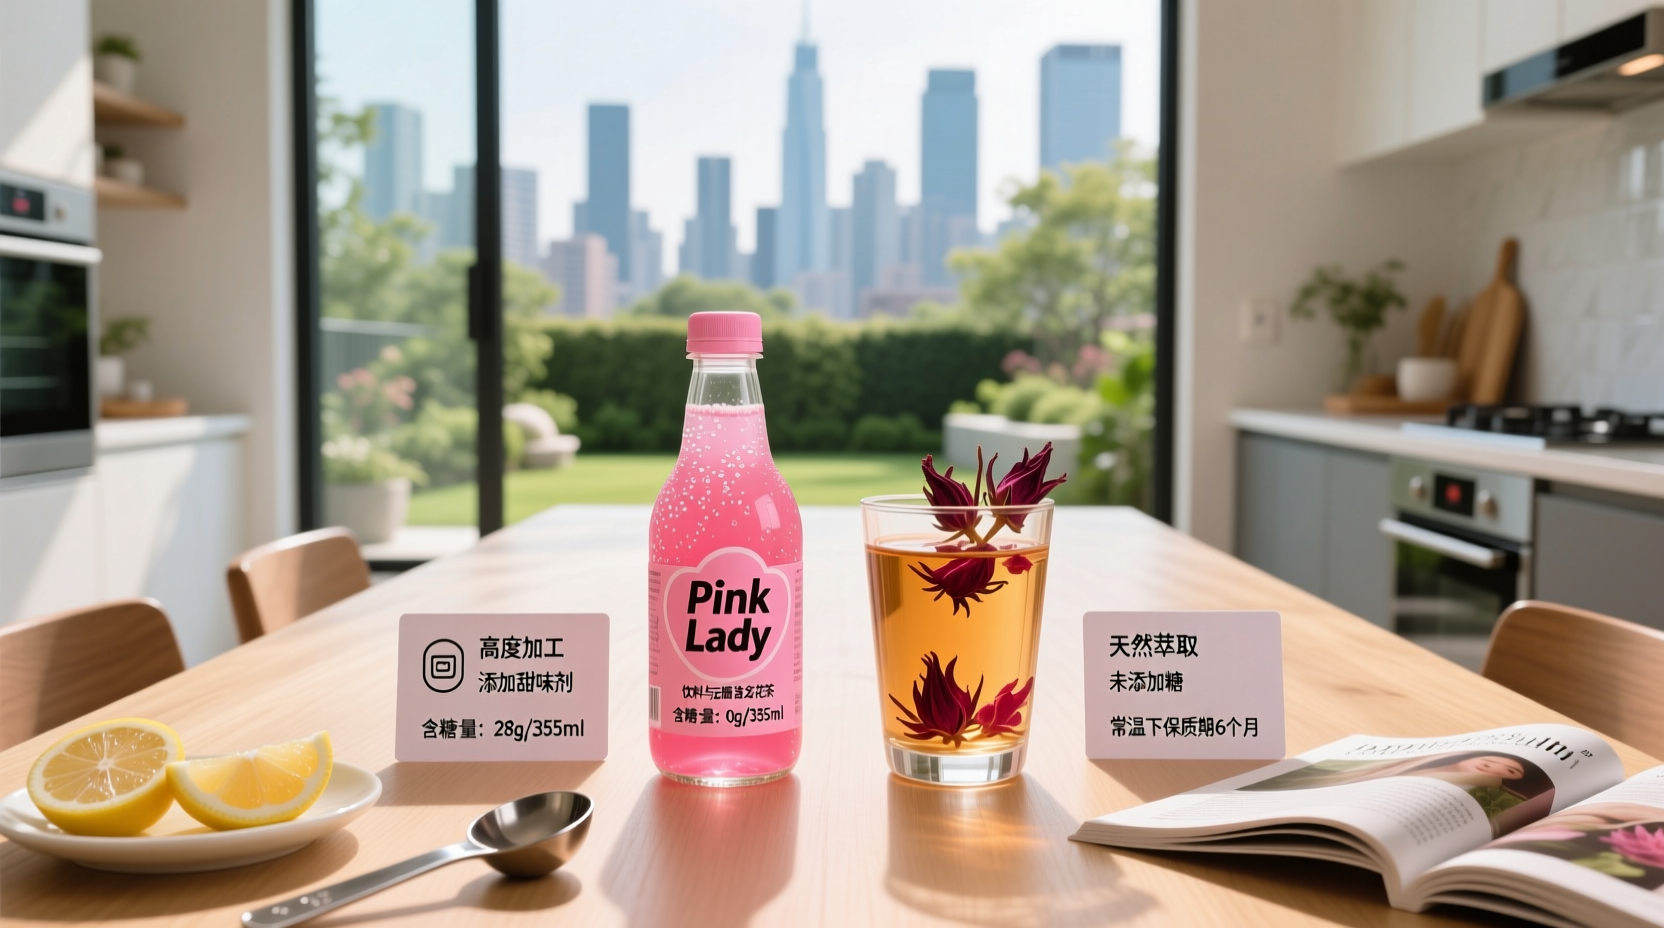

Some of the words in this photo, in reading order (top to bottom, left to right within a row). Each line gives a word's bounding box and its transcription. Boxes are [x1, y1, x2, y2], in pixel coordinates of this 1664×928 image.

[686, 577, 771, 615] Pink
[479, 635, 565, 660] 高度加工
[685, 617, 772, 662] Lady
[1109, 632, 1199, 658] 天然萃取
[477, 671, 573, 694] 添加甜味剂
[1109, 670, 1184, 693] 未添加糖
[1110, 715, 1259, 738] 常温下保质期6个月
